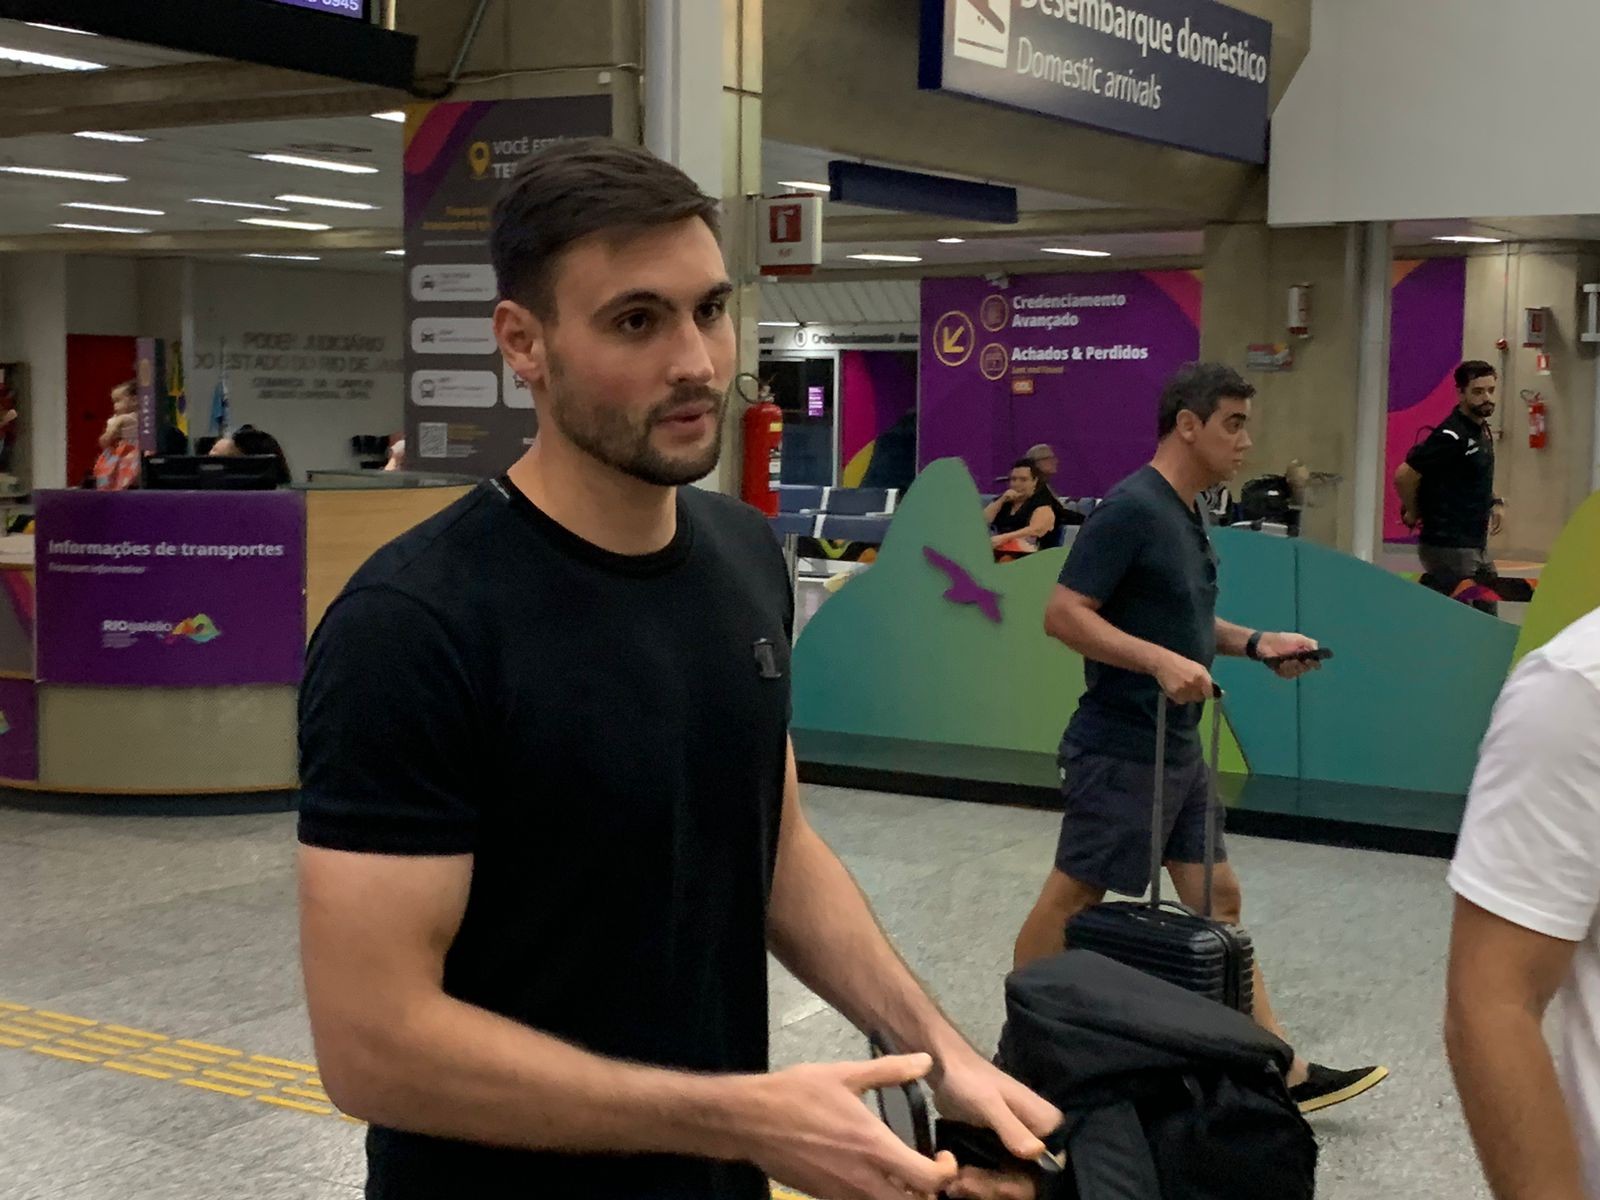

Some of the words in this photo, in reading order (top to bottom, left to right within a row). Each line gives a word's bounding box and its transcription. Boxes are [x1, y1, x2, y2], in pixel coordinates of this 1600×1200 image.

[1020, 0, 1172, 57] esembarque
[1176, 17, 1267, 84] doméstico
[1016, 37, 1102, 94] Domestic
[1104, 68, 1162, 110] arrivals
[492, 136, 529, 155] VOCÊ
[1013, 293, 1126, 309] Credenciamento
[1012, 312, 1080, 330] Avançado
[1011, 346, 1069, 361] Achados
[1071, 346, 1083, 360] &
[1086, 345, 1148, 360] Perdidos
[49, 540, 151, 558] Informações
[155, 541, 177, 556] de
[181, 543, 284, 560] transportes
